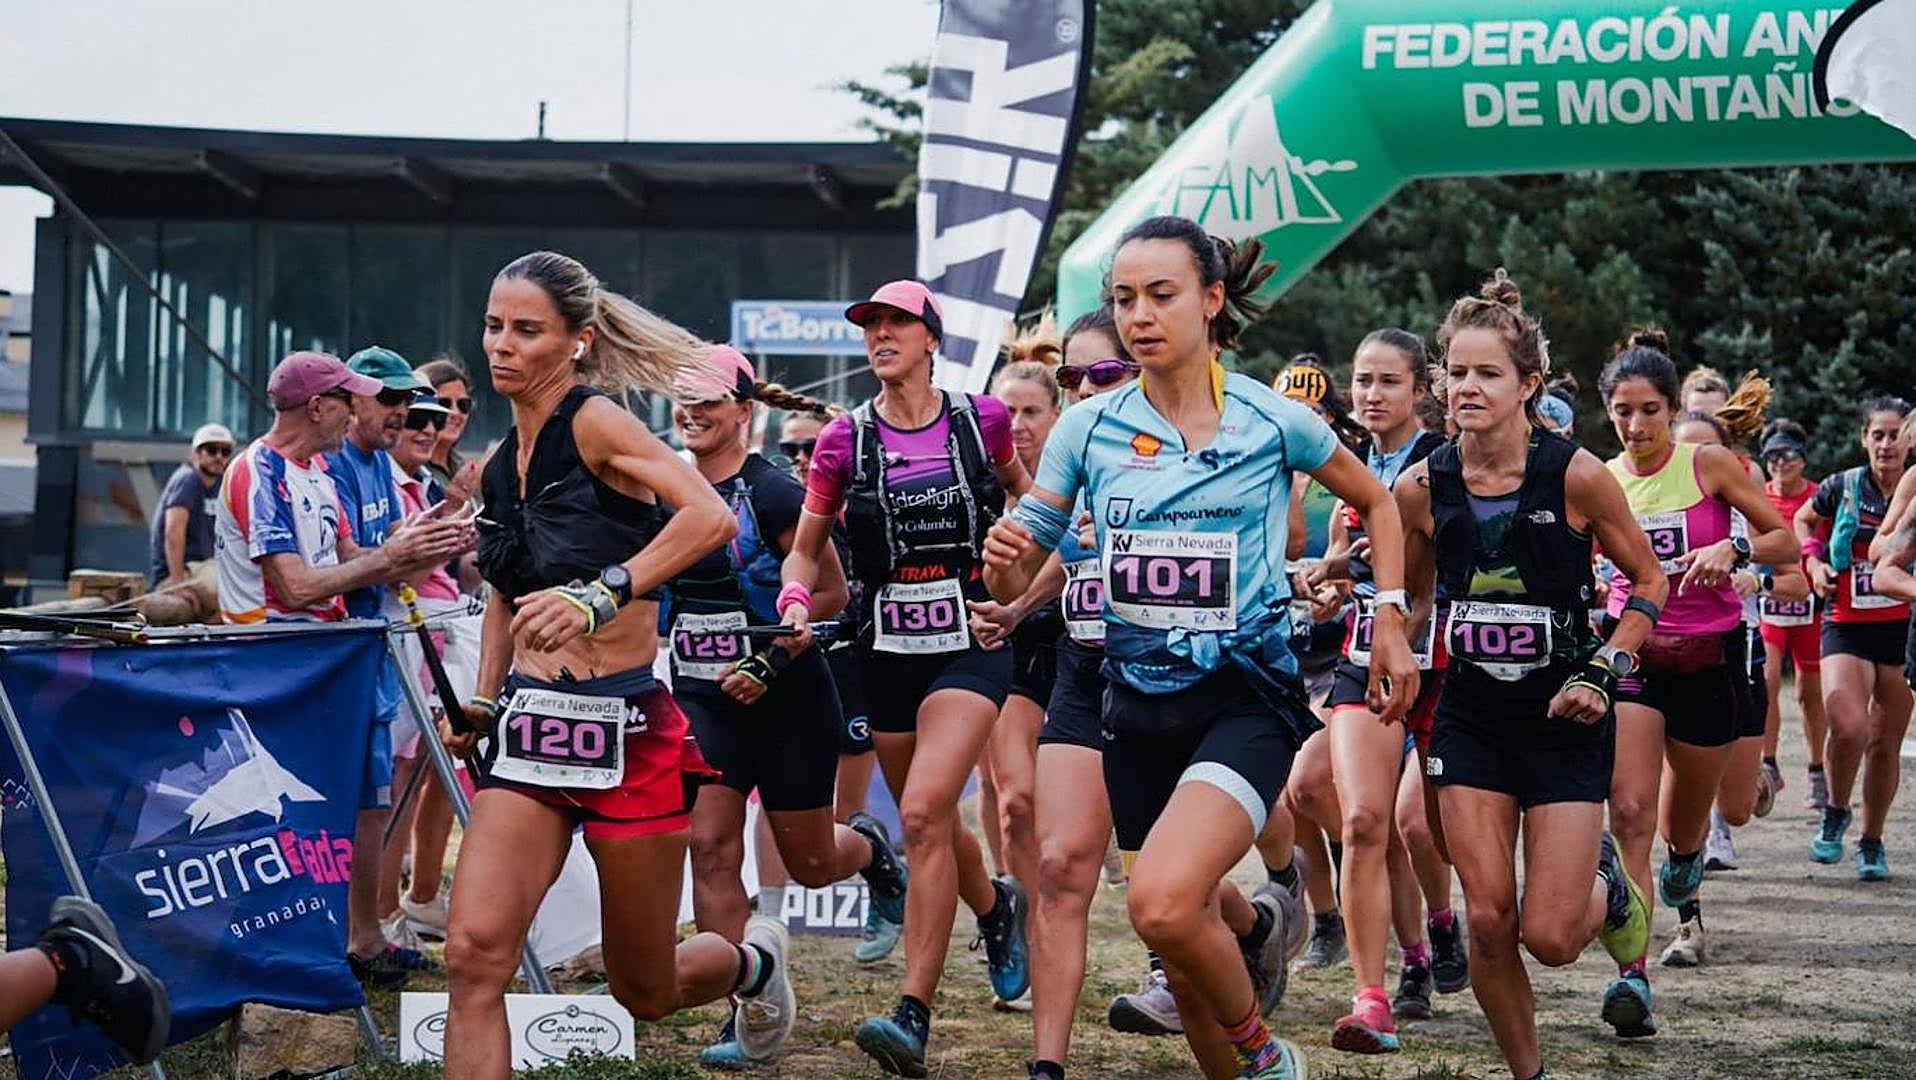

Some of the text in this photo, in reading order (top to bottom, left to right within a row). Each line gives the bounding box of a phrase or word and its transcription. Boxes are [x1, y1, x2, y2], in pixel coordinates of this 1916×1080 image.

[1362, 5, 1846, 69] FEDERACIÓN AN
[1462, 81, 1543, 127] DE
[904, 518, 957, 533] Columbia
[1136, 534, 1174, 548] Sierra
[1178, 535, 1232, 550] Nevada
[1113, 557, 1212, 598] 101
[1069, 580, 1104, 612] 10
[1767, 600, 1806, 614] 125
[883, 600, 954, 630] 130
[676, 632, 738, 657] 129
[1453, 623, 1536, 655] 102
[568, 699, 620, 715] Nevada
[509, 715, 606, 759] 120
[538, 1018, 609, 1034] Carmen
